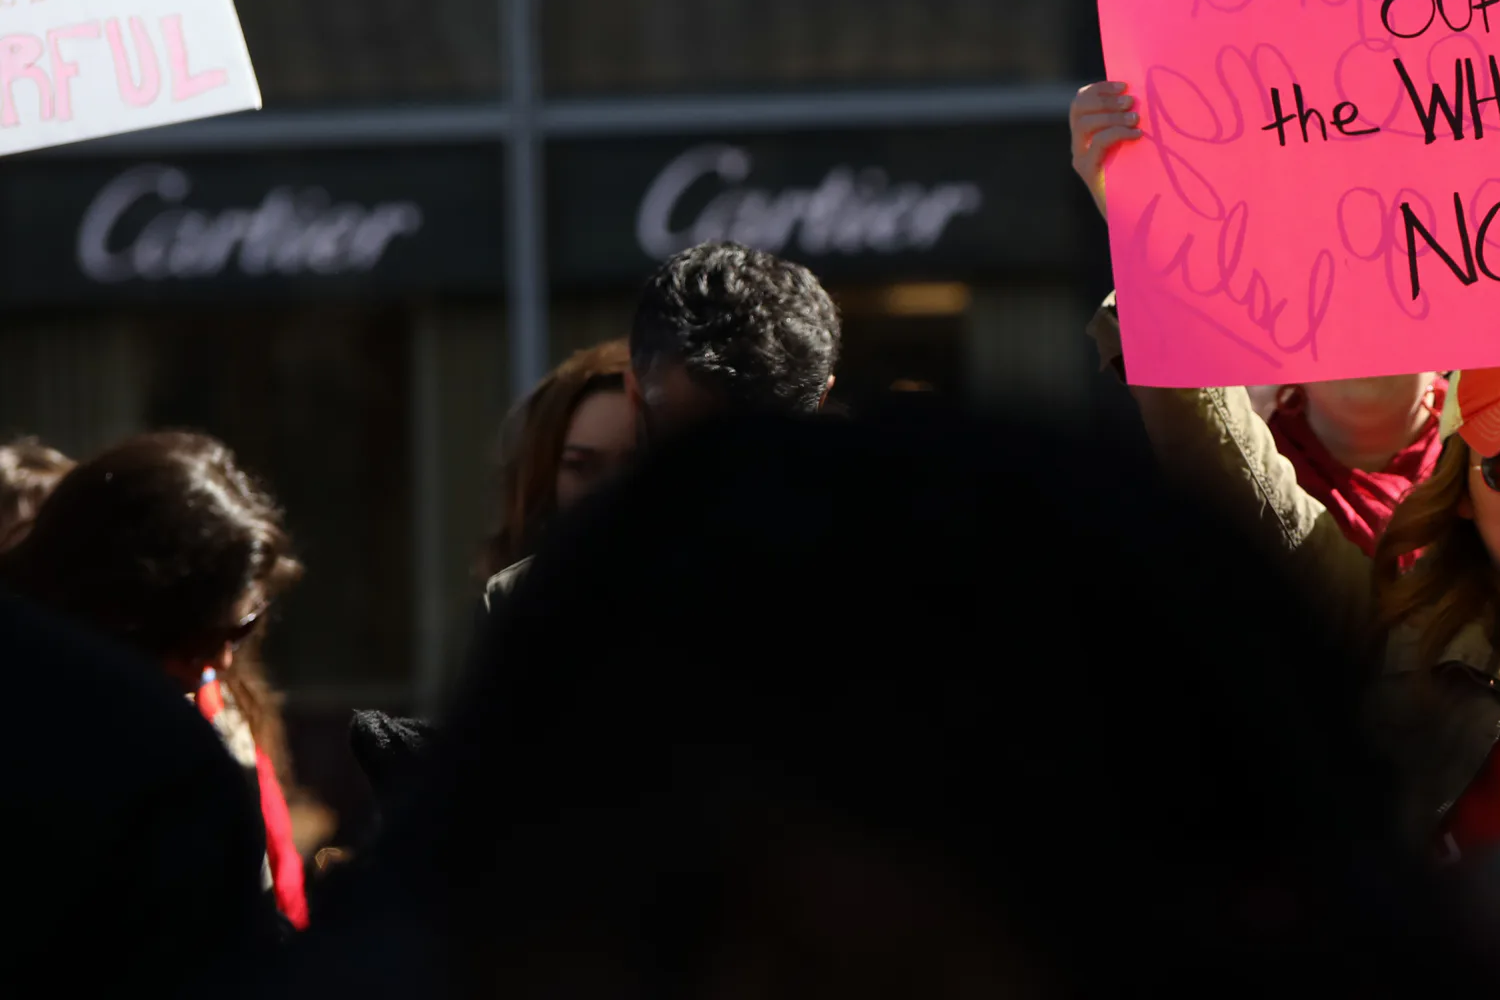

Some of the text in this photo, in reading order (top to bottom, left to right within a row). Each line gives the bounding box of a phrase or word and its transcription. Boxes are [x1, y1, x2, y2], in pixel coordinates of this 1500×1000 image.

[1261, 83, 1381, 146] the
[77, 163, 424, 281] Cartier
[636, 143, 983, 261] Cartier
